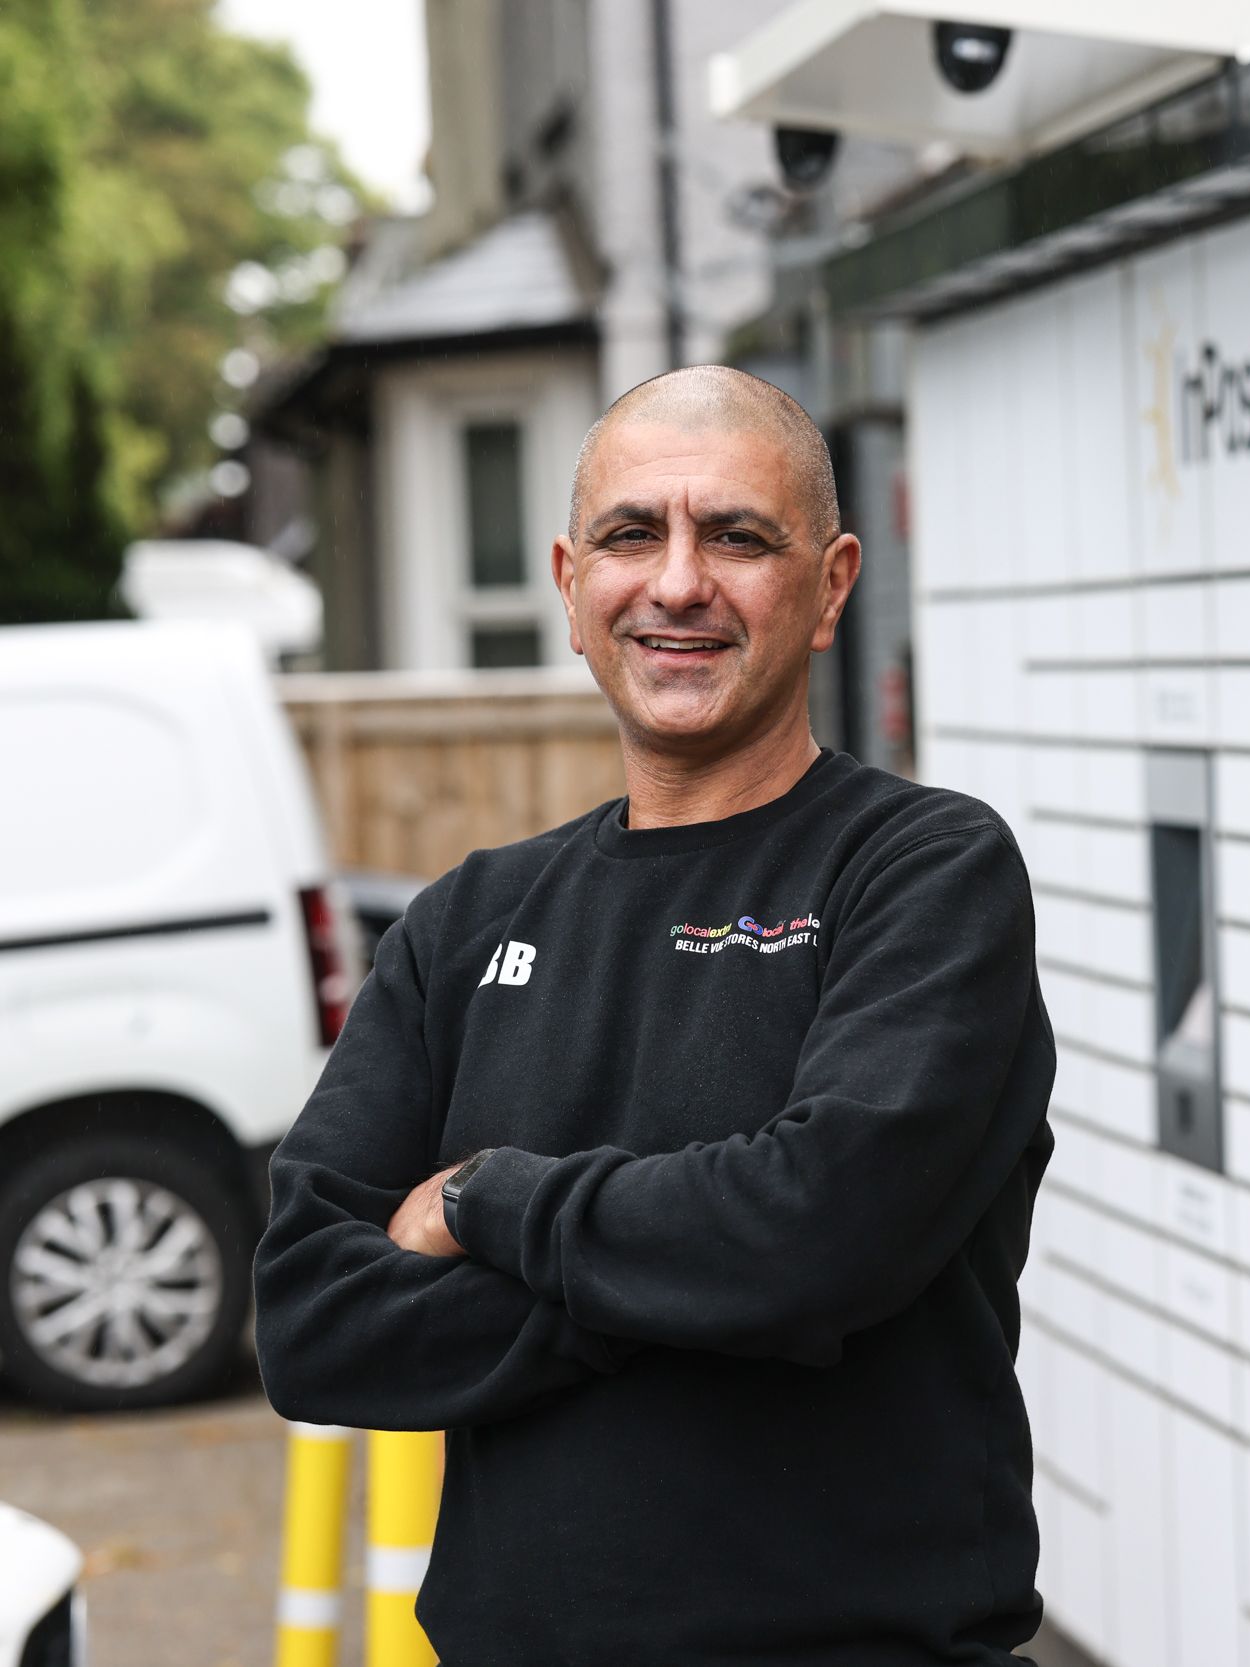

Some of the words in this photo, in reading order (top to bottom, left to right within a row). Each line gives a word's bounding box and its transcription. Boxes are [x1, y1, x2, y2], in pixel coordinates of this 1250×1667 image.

[675, 939, 710, 954] BELLE
[710, 940, 724, 953] VUE
[724, 933, 759, 950] STORES
[759, 936, 787, 954] NORTH
[786, 932, 811, 946] EAST
